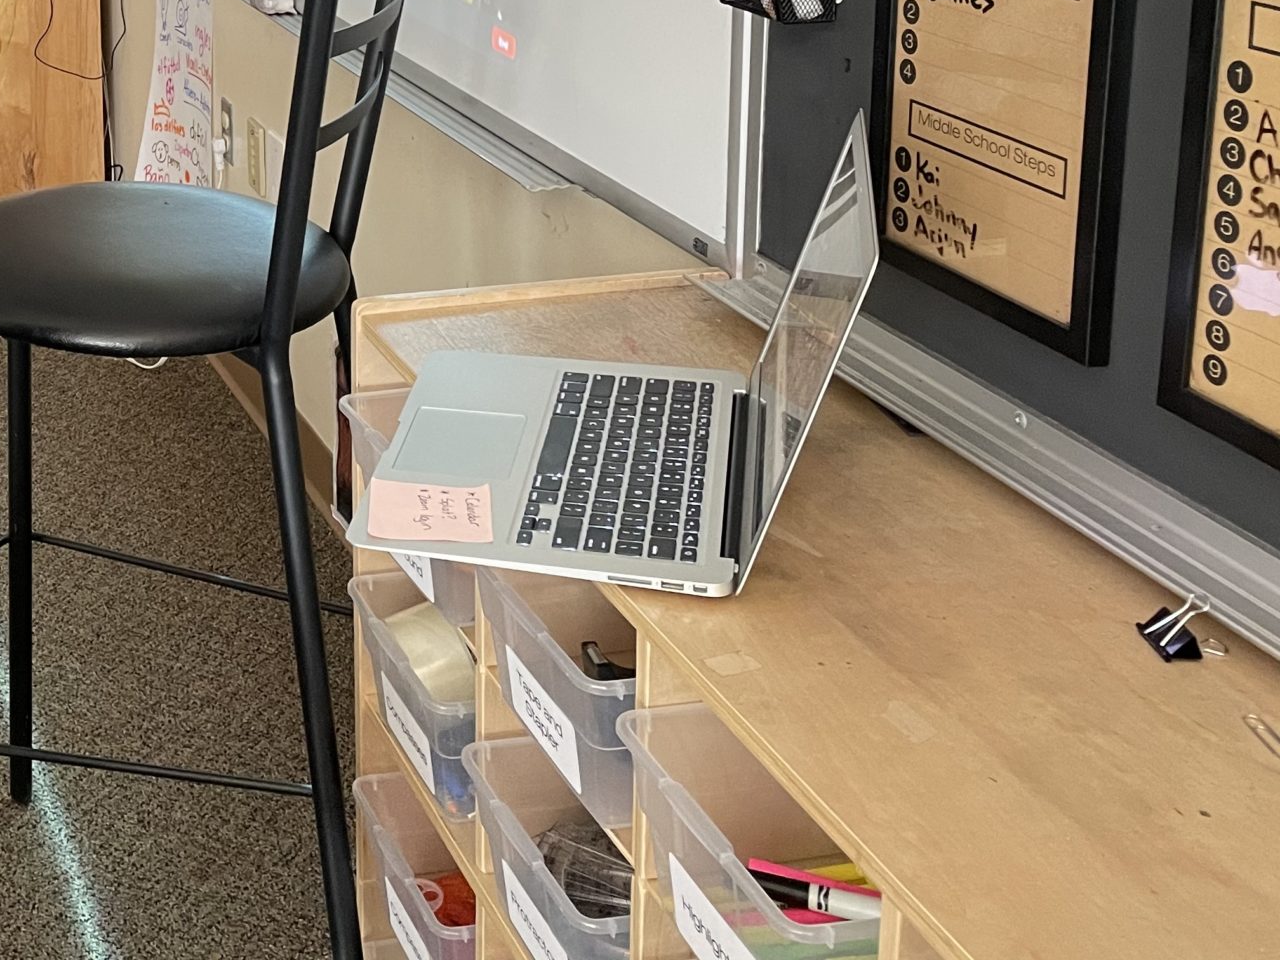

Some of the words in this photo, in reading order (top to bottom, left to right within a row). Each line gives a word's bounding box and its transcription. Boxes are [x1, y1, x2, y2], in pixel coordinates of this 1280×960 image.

[916, 151, 940, 187] Kai
[918, 110, 961, 139] Middle
[963, 127, 1010, 159] School
[1013, 147, 1056, 178] Steps
[516, 668, 542, 711] Tape
[543, 707, 564, 739] and
[525, 699, 559, 752] Stapler
